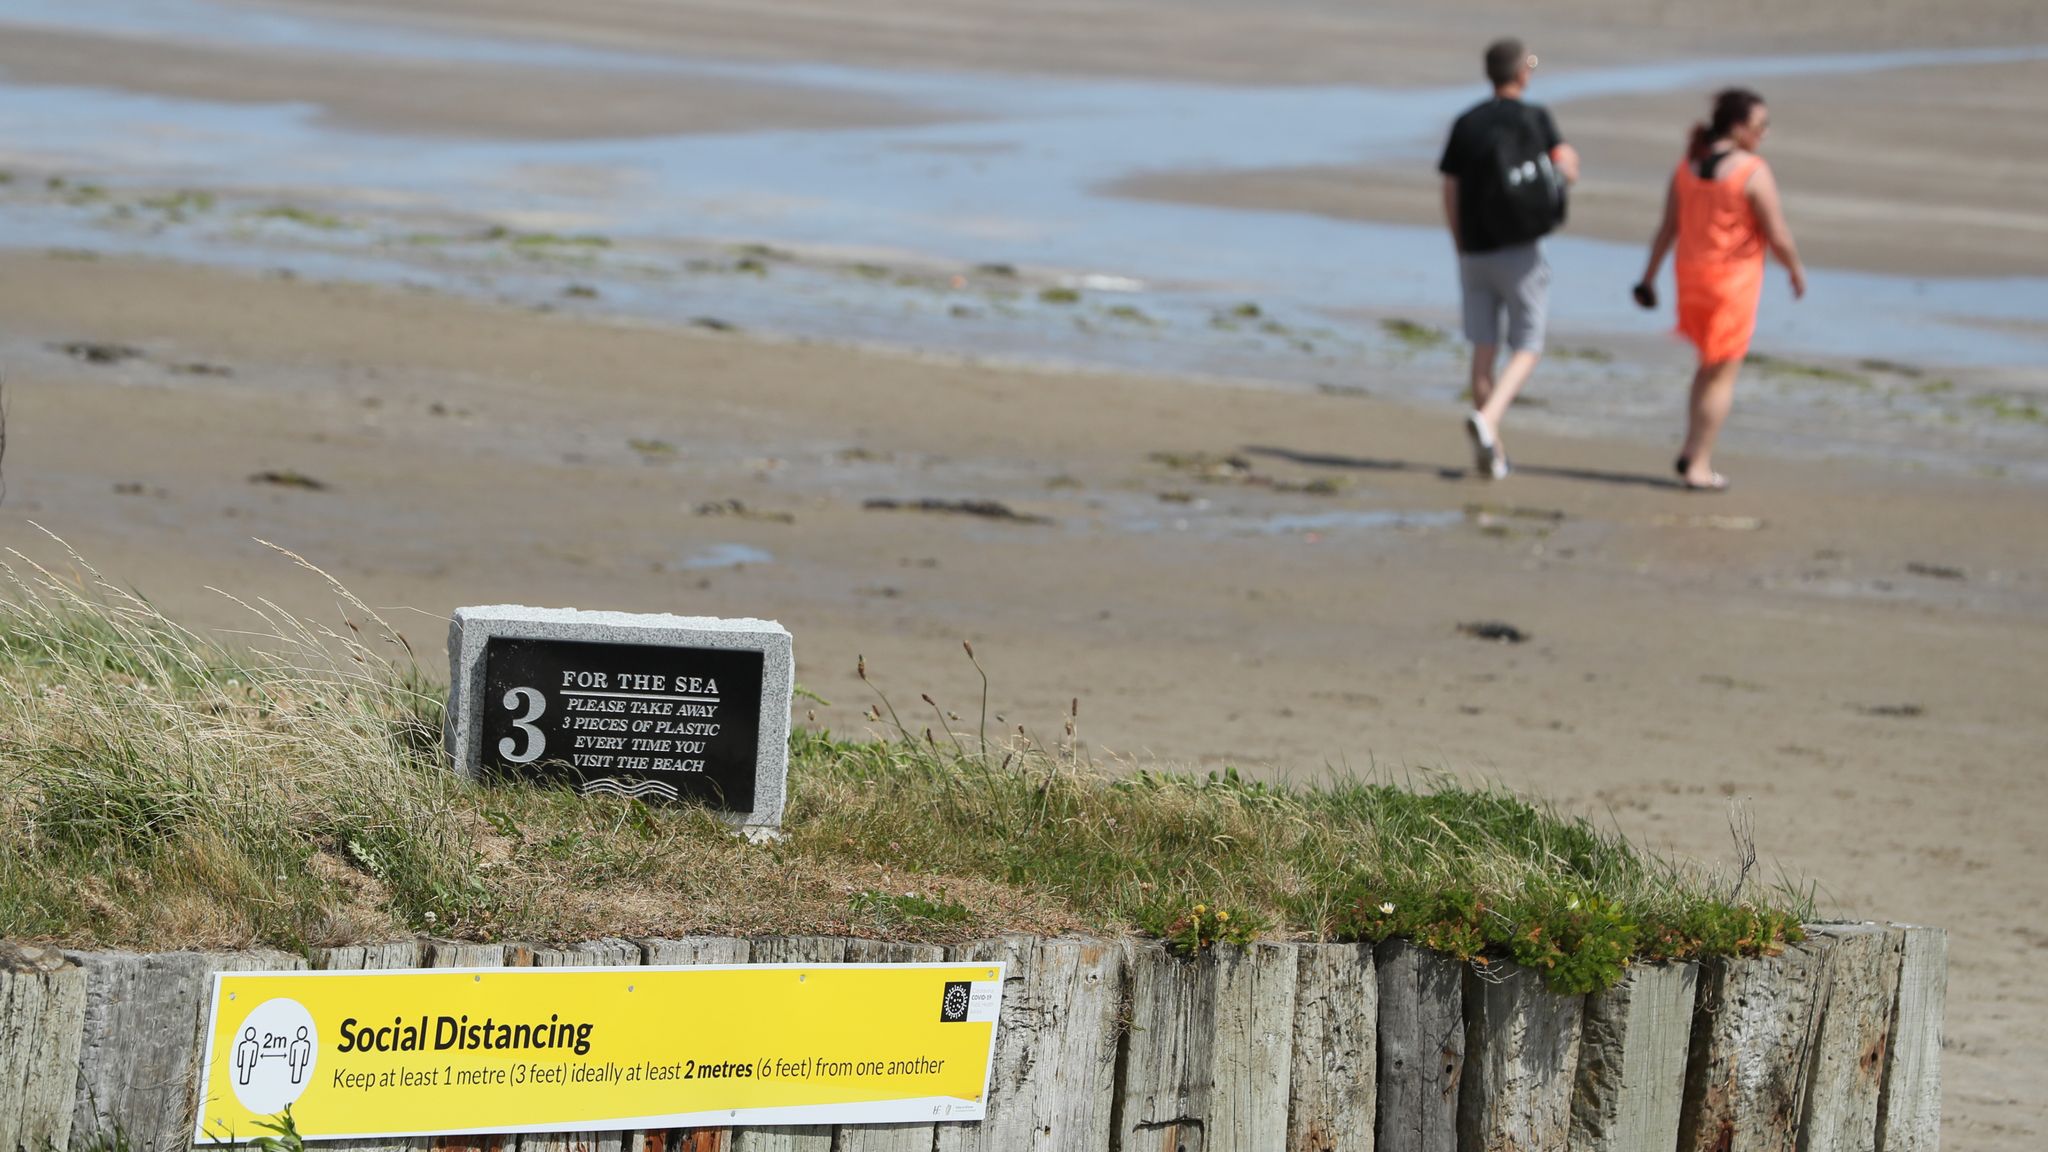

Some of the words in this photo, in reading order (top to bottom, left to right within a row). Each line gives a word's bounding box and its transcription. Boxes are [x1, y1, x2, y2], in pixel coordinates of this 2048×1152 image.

[562, 671, 608, 688] FOR
[617, 673, 666, 691] THE
[675, 676, 719, 694] SEA
[567, 698, 627, 713] PLEASE
[630, 701, 673, 715] TAKE
[676, 704, 718, 718] AWAY
[498, 686, 547, 763] 3
[562, 716, 571, 729] 3
[573, 717, 629, 731] PIECES
[631, 719, 653, 733] OF
[655, 721, 720, 736] PLASTIC
[574, 735, 628, 750] EVERY
[631, 738, 672, 752] TIME
[675, 740, 706, 754] YOU
[573, 753, 613, 768] VISIT
[617, 756, 649, 770] THE
[652, 758, 705, 772] BEACH
[263, 1032, 287, 1049] 2m
[337, 1016, 429, 1053] Social
[434, 1013, 594, 1056] Distancing
[333, 1068, 376, 1092] Keep
[379, 1070, 396, 1087] at
[399, 1066, 439, 1087] least
[443, 1066, 452, 1086] 1
[456, 1067, 506, 1085] metre
[509, 1063, 527, 1087] (3
[529, 1062, 568, 1086] feet)
[571, 1062, 624, 1086] ideally
[626, 1063, 642, 1081] at
[645, 1061, 682, 1081] least
[684, 1060, 695, 1080] 2
[697, 1060, 753, 1079] metres
[756, 1057, 772, 1080] (6
[775, 1056, 812, 1080] feet)
[815, 1057, 853, 1077] from
[856, 1062, 884, 1076] one
[887, 1055, 945, 1075] another
